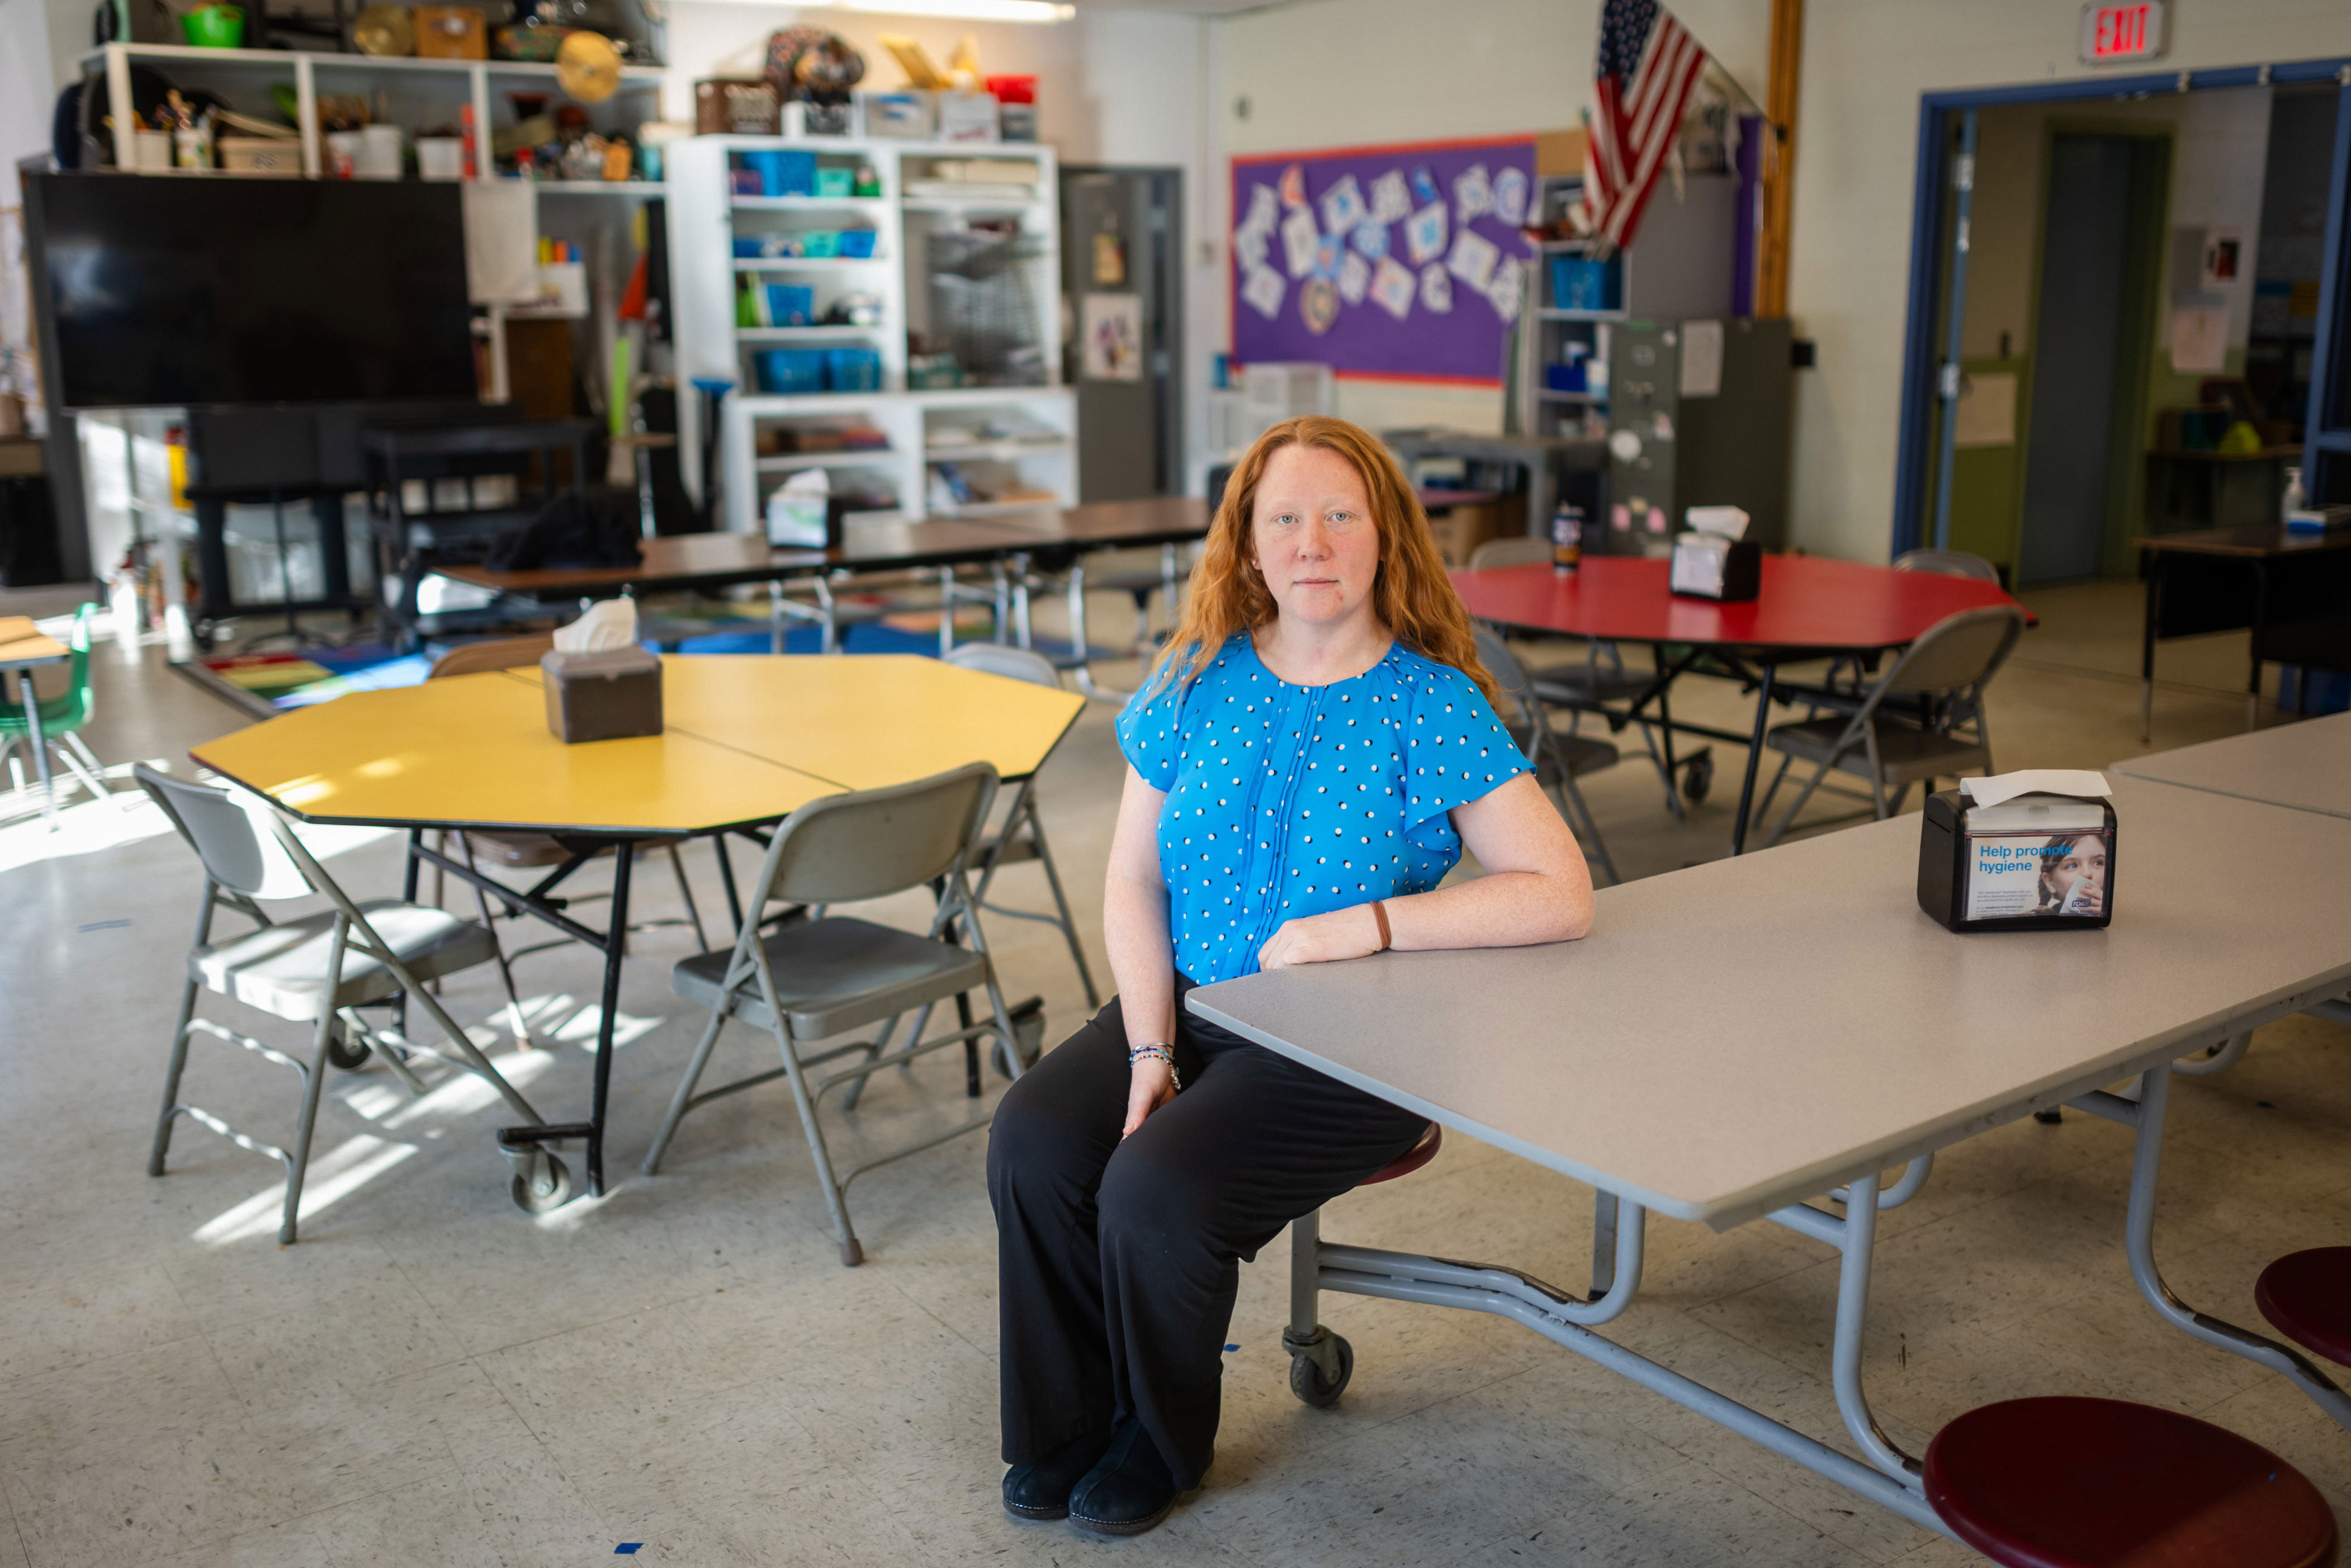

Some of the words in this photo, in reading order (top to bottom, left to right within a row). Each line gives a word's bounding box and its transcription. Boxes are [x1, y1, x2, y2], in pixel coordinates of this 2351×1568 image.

[2094, 3, 2150, 57] EXIT
[1980, 845, 2012, 859] Help
[2016, 844, 2073, 859] promote
[1979, 860, 2032, 874] hygiene
